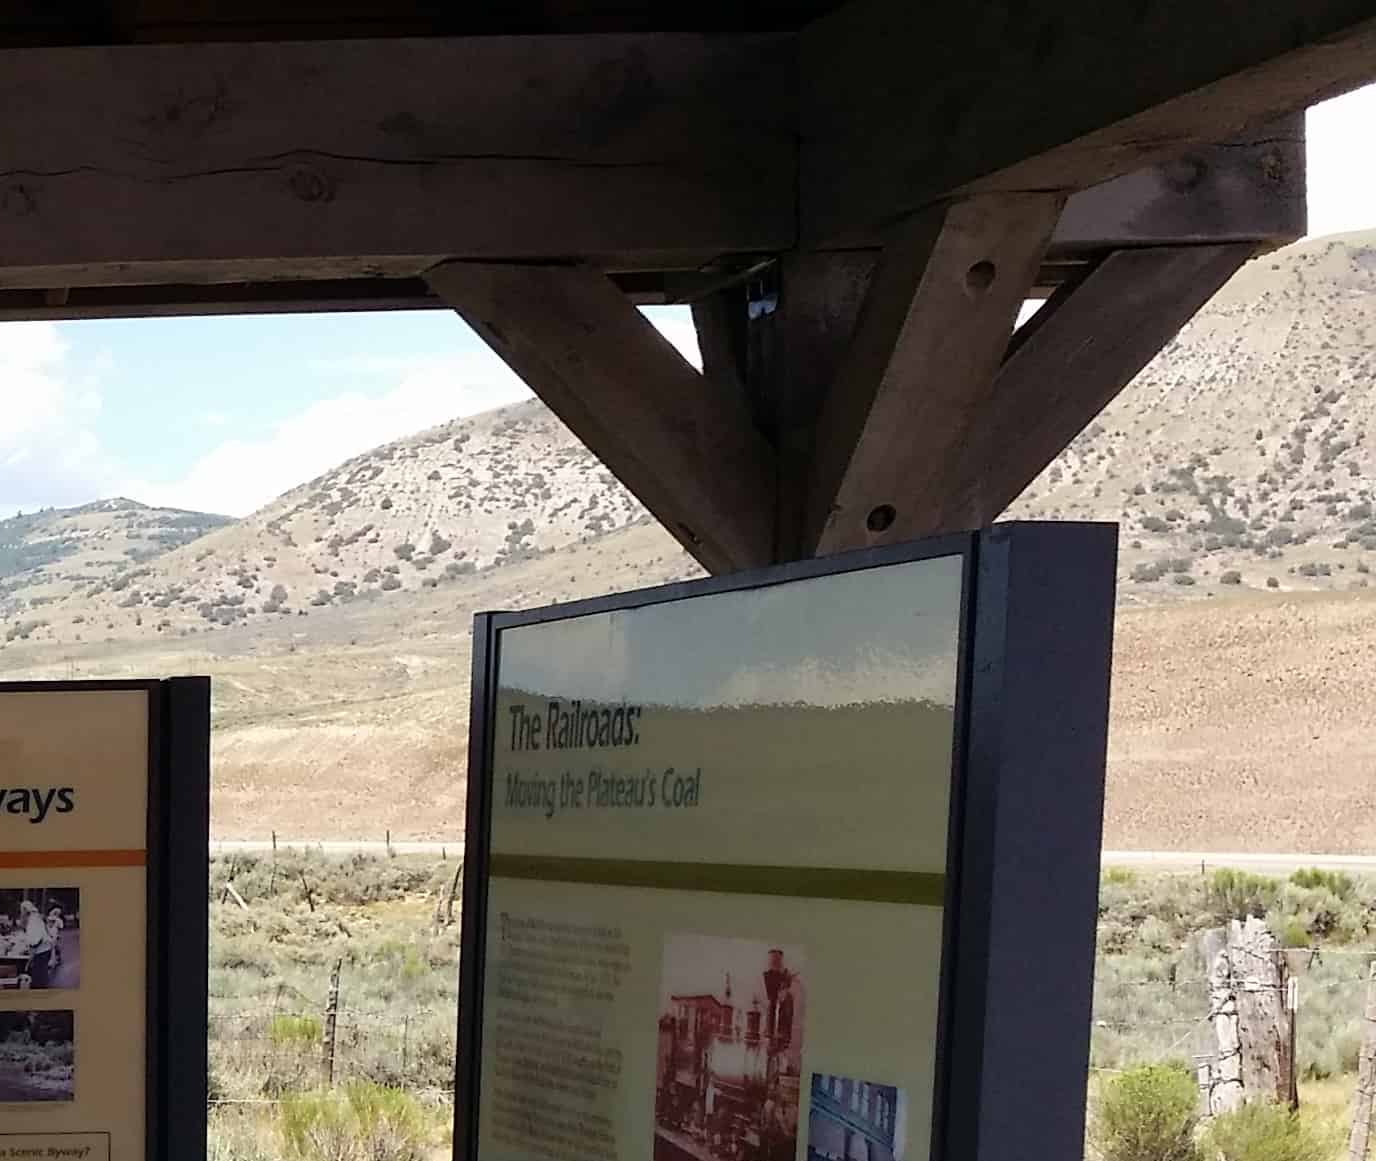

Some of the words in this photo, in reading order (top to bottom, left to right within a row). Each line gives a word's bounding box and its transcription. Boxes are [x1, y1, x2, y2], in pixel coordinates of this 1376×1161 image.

[509, 704, 543, 751] The
[546, 699, 642, 751] Railroads:
[504, 770, 557, 817] Moving
[560, 769, 584, 808] the
[587, 767, 657, 809] Plateau's
[661, 767, 702, 808] Coal
[9, 1146, 43, 1158] Scenic
[46, 1145, 92, 1160] Byway?
